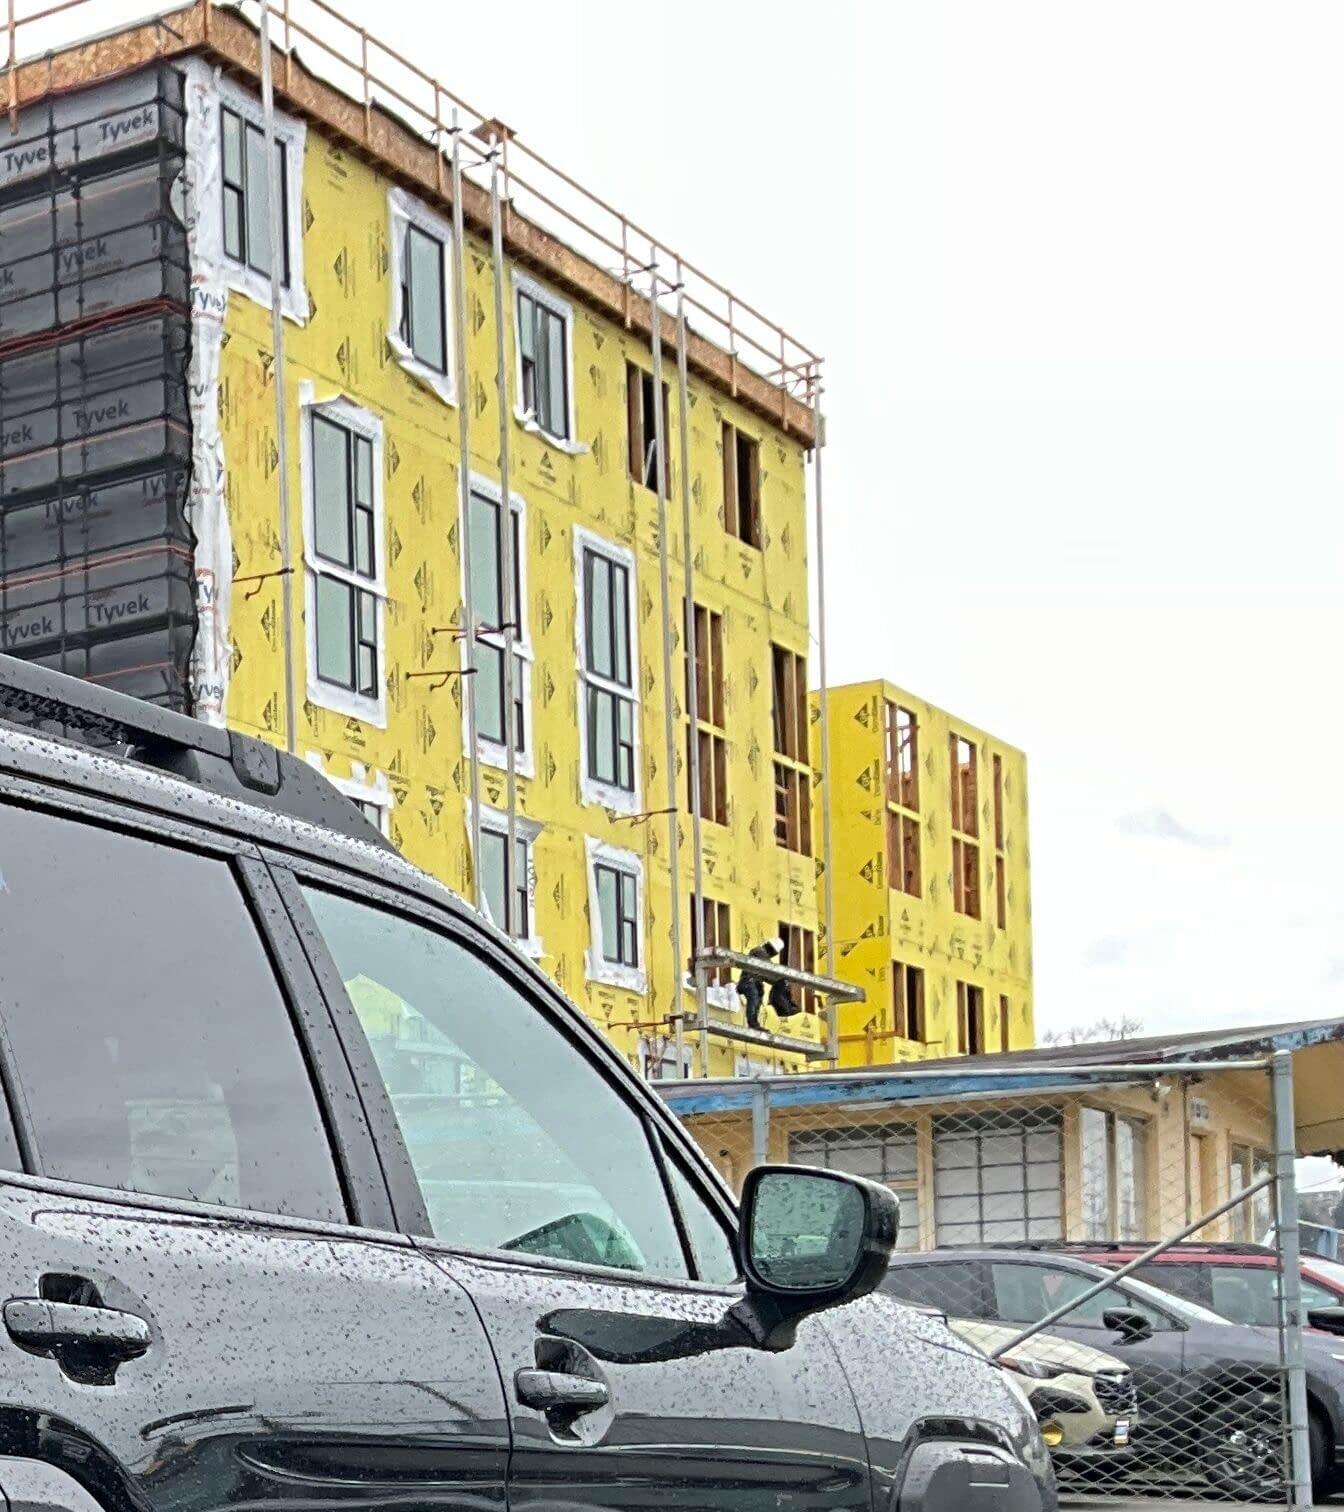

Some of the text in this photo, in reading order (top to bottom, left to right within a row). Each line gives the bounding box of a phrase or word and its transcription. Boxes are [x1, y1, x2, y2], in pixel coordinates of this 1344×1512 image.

[99, 108, 153, 141] Tyvek
[4, 147, 49, 172] Tyve
[73, 399, 129, 430] Tyvek
[94, 595, 149, 625] Tyvek
